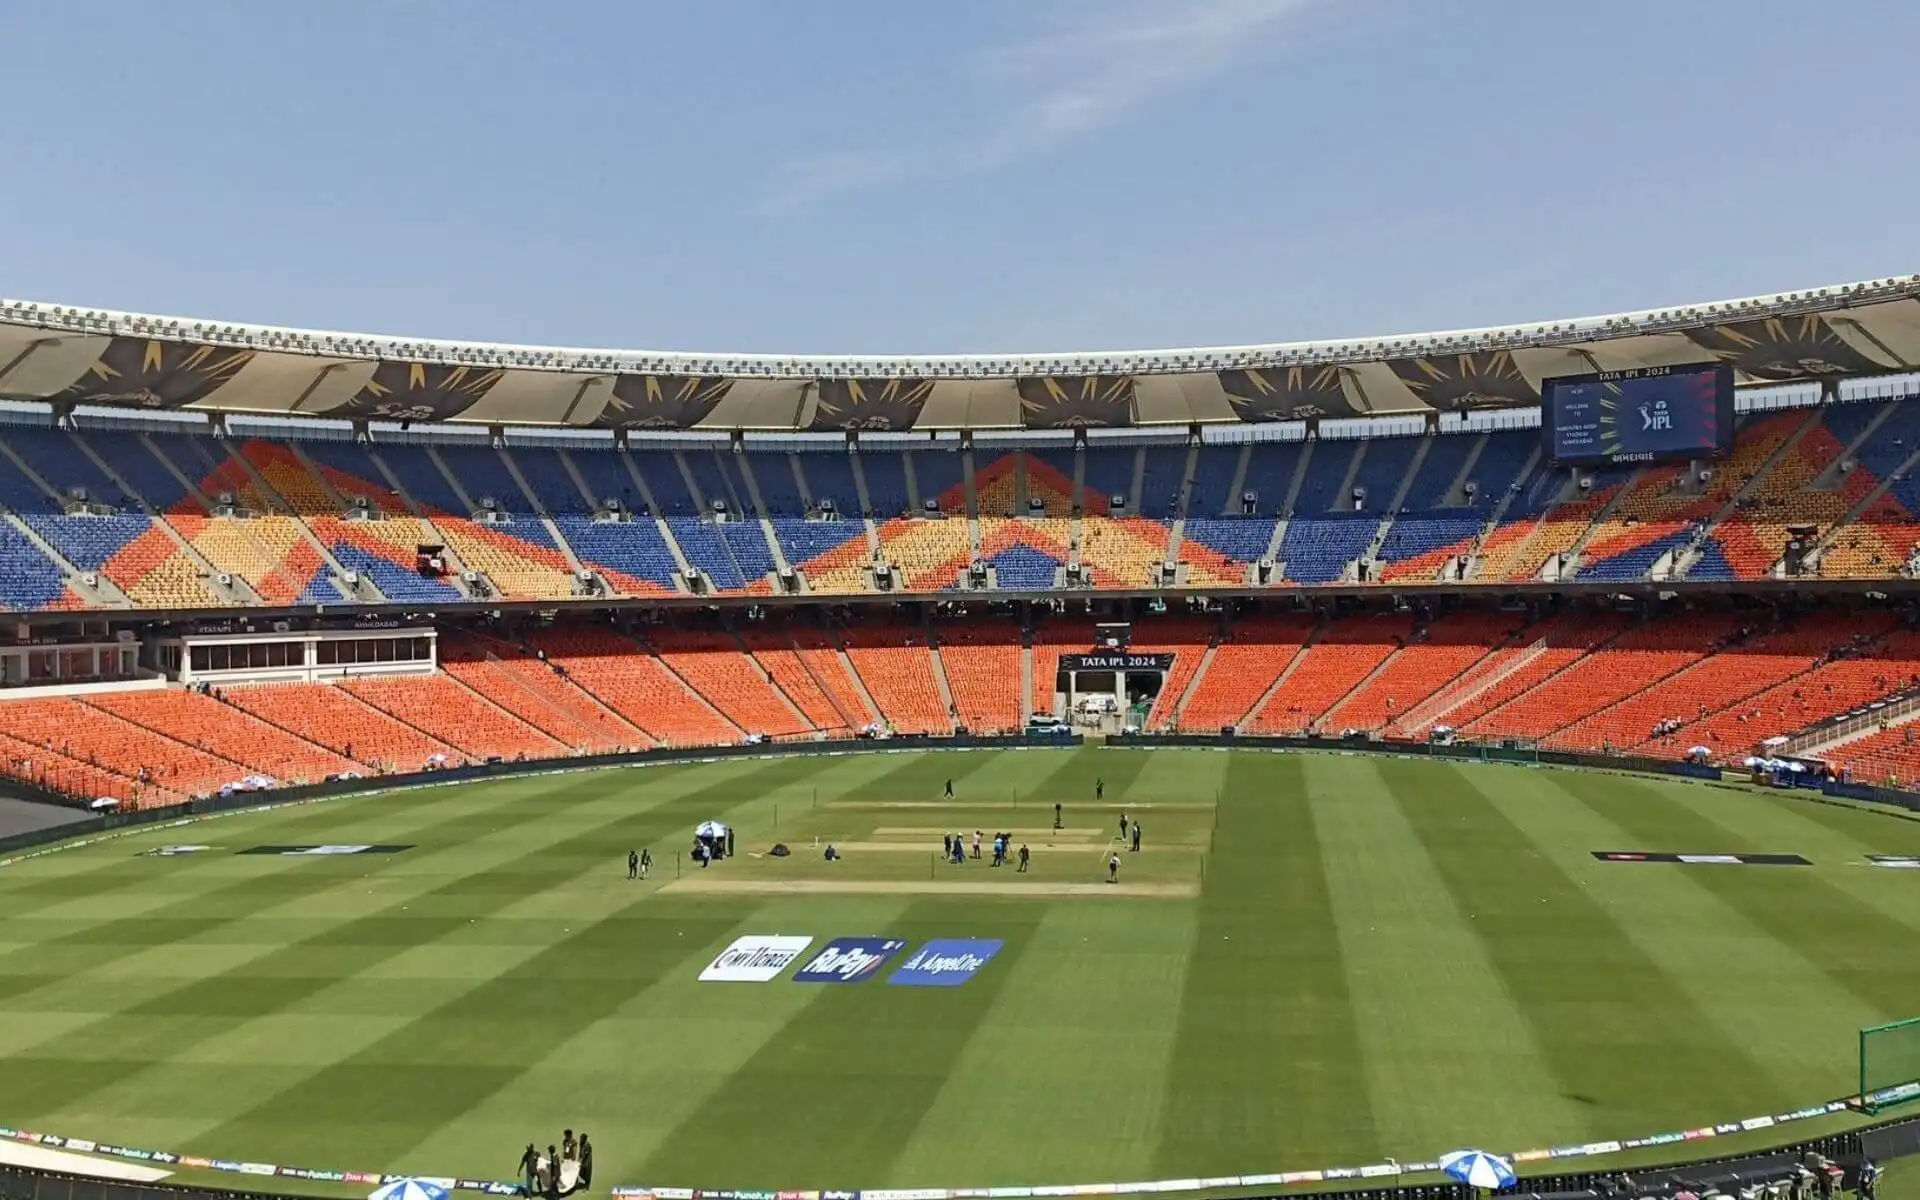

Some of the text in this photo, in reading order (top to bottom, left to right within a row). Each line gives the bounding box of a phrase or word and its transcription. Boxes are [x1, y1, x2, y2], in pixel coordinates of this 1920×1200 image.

[1600, 366, 1670, 380] TATA IPL 2024
[1653, 415, 1673, 429] IPL
[1081, 656, 1156, 667] TATA IPL 2024
[801, 947, 880, 980] RuPay
